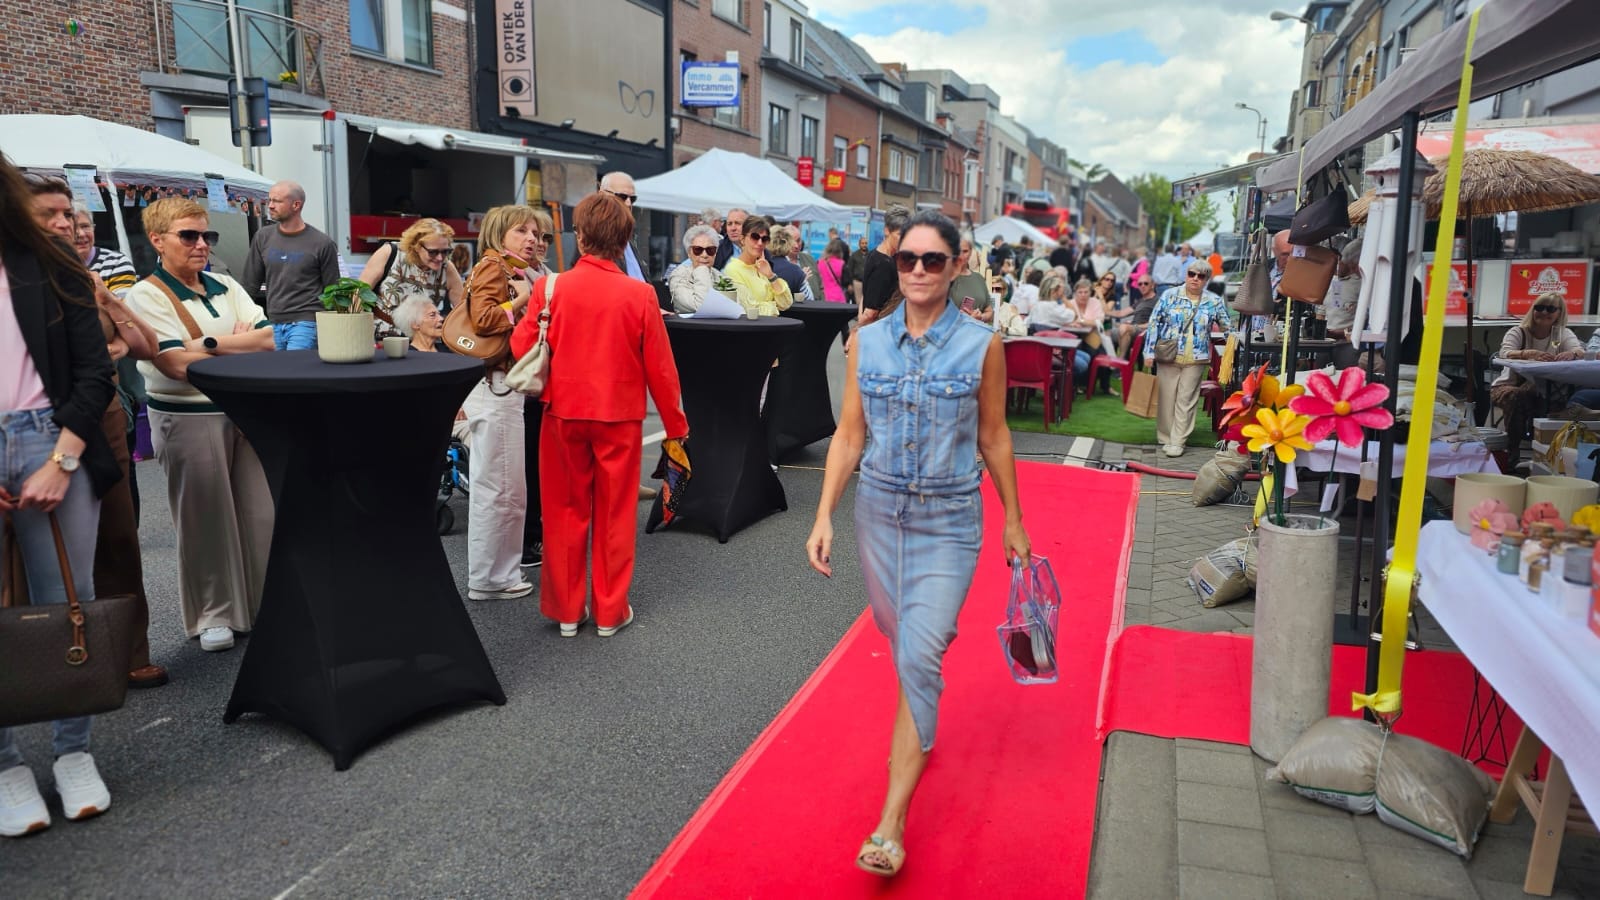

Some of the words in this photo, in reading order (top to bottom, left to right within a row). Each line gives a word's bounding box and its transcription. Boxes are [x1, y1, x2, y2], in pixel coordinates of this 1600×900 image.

[513, 0, 526, 29] DER
[503, 12, 515, 64] OPTIEK
[515, 32, 527, 63] VAN
[687, 71, 712, 81] Immo
[687, 81, 735, 92] Vercammen
